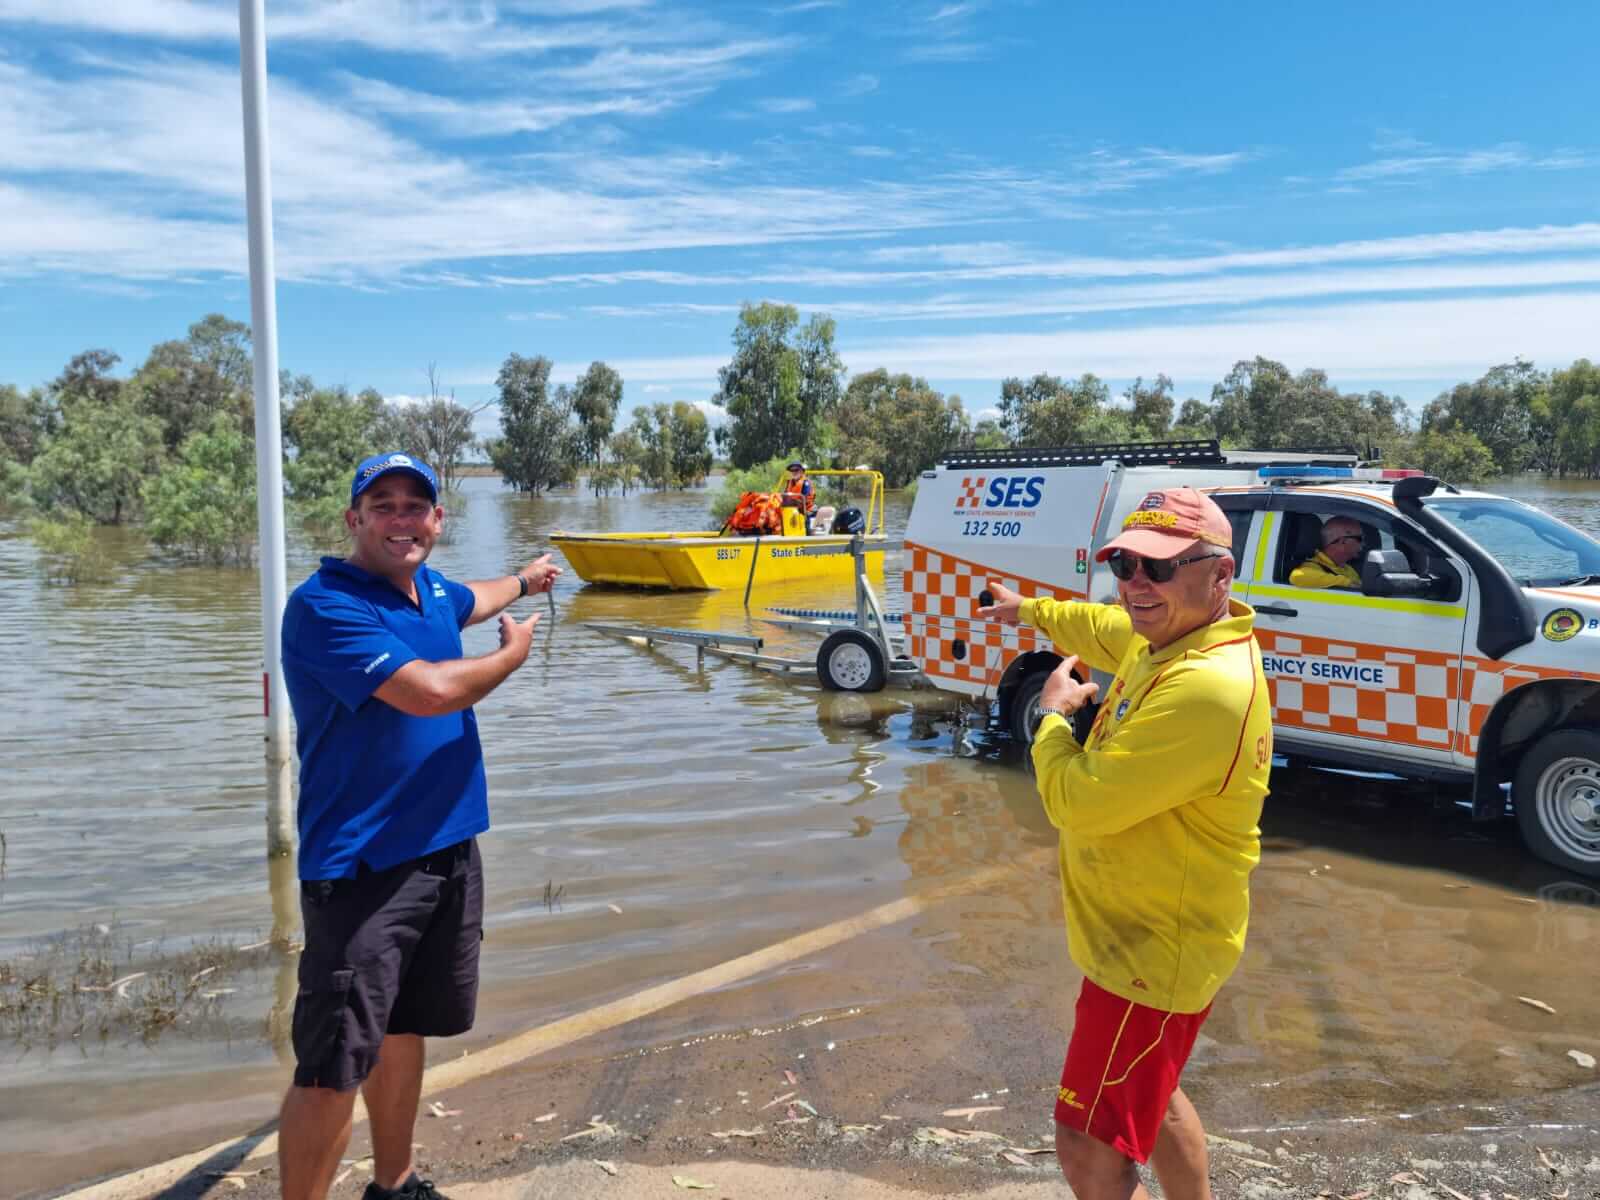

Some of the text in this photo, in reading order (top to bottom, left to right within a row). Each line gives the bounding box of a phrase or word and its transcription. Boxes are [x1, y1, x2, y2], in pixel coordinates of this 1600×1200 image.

[985, 476, 1045, 508] SES
[962, 520, 1021, 537] 132 500
[771, 548, 793, 558] State
[1311, 662, 1384, 683] SERVICE
